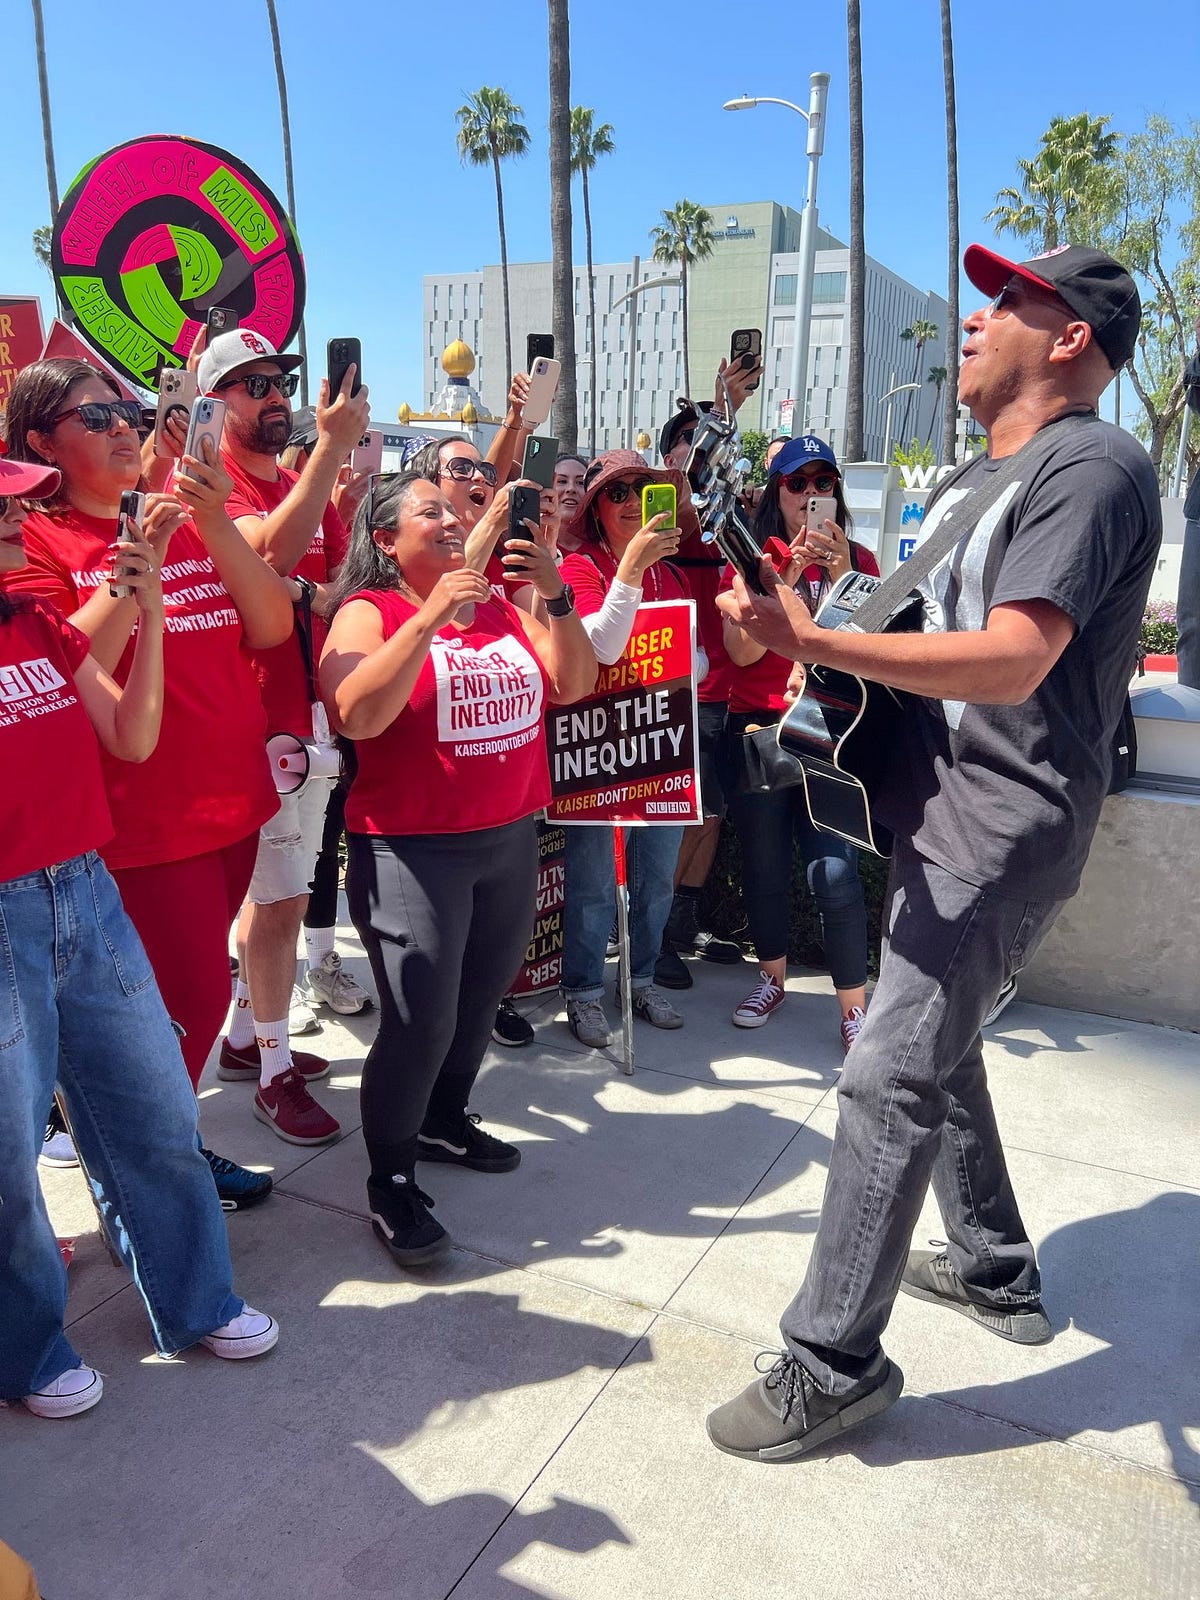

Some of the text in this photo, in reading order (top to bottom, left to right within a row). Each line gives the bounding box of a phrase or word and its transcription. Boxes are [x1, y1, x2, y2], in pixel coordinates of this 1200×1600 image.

[64, 161, 147, 259] WHEEL
[152, 152, 199, 191] OF
[208, 178, 269, 246] MIS.
[73, 283, 177, 388] KAISER
[803, 438, 820, 452] LA
[166, 609, 238, 633] CONTRACT!!!
[450, 666, 530, 702] END THE
[597, 656, 664, 692] APISTS
[5, 696, 45, 714] UNION
[46, 690, 61, 701] OF
[23, 695, 77, 719] WORKERS
[450, 690, 536, 731] INEQUITY
[555, 689, 670, 746] END THE
[455, 725, 540, 757] KAISERDONTDENY.ORG
[554, 724, 685, 783] INEQUITY
[556, 774, 691, 814] KAISERDONTDENY.ORG
[646, 802, 690, 813] NUHW
[256, 1037, 279, 1048] SC
